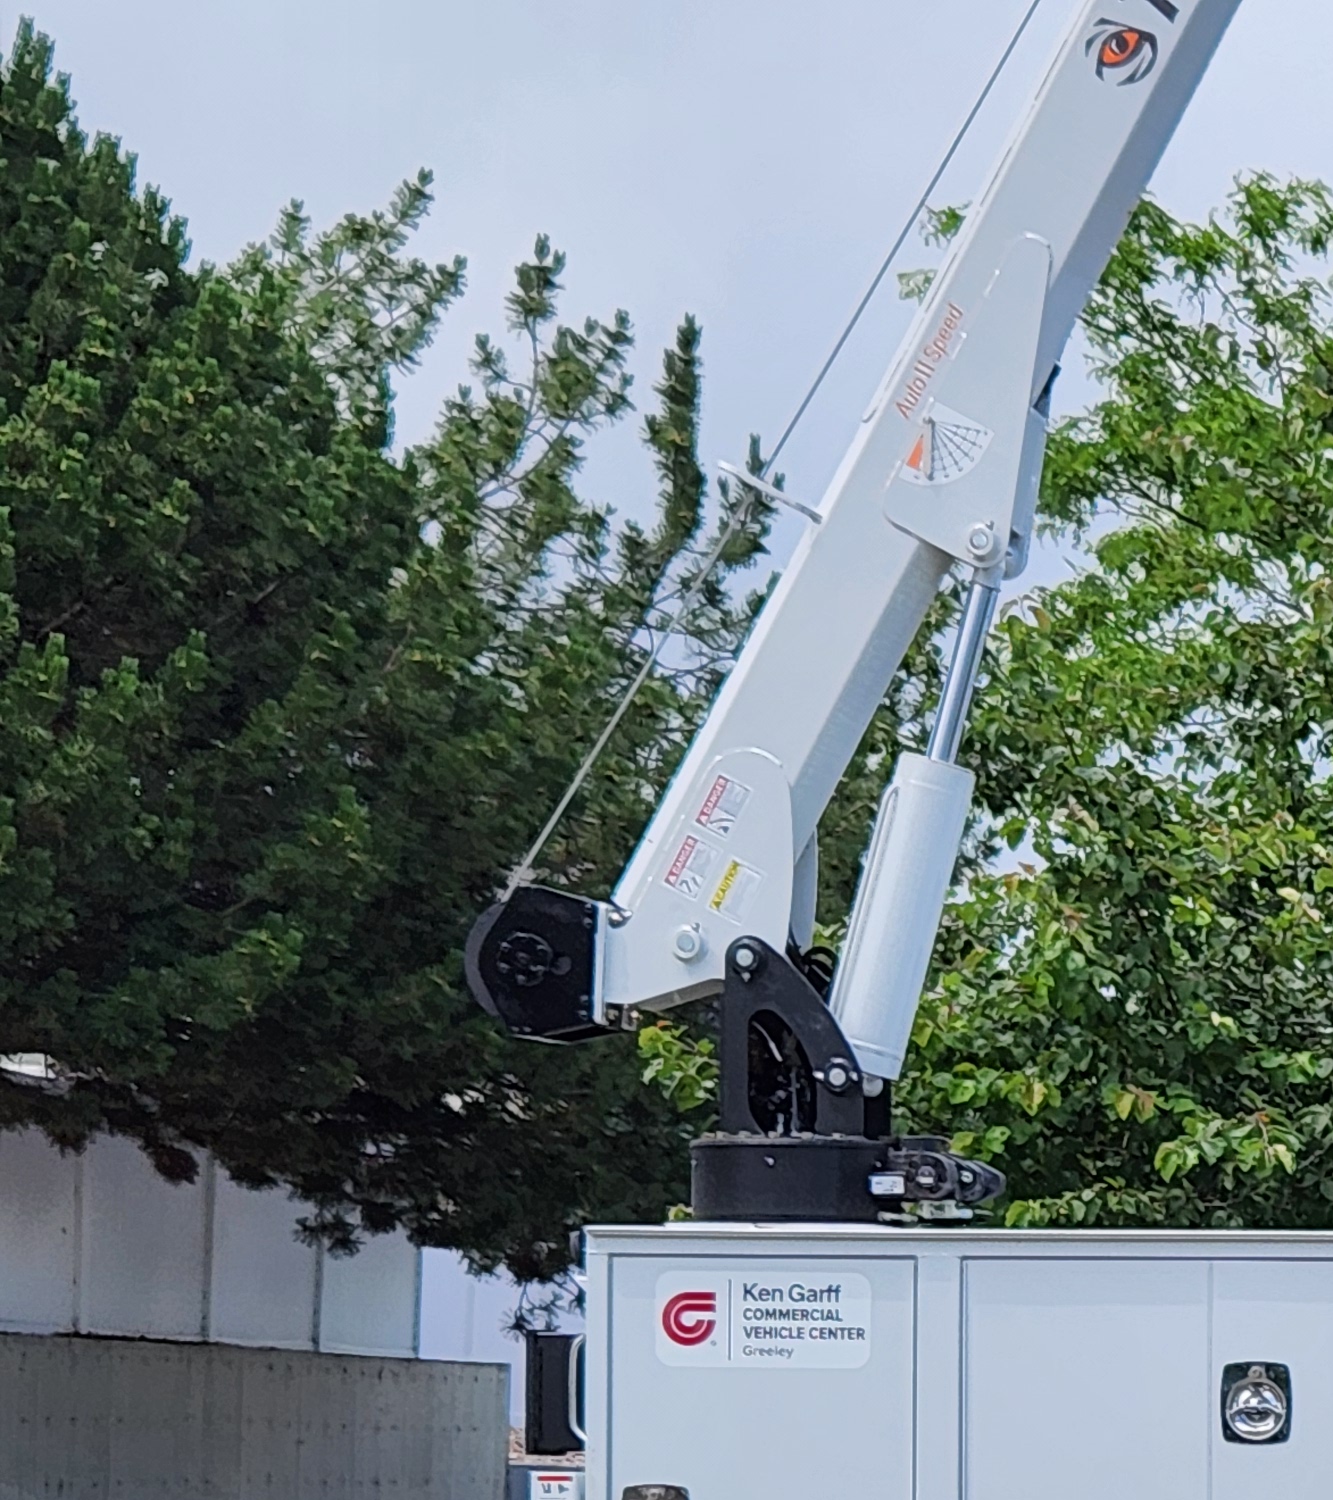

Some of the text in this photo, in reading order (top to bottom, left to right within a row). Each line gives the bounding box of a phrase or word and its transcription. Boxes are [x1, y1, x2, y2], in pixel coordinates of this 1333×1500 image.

[923, 302, 964, 363] Speed
[705, 777, 728, 815] DANGER
[742, 1283, 842, 1303] Ken Garff
[742, 1307, 844, 1322] COMMERCIAL
[742, 1326, 866, 1341] VEHICLE CENTER
[742, 1345, 795, 1359] Greeley
